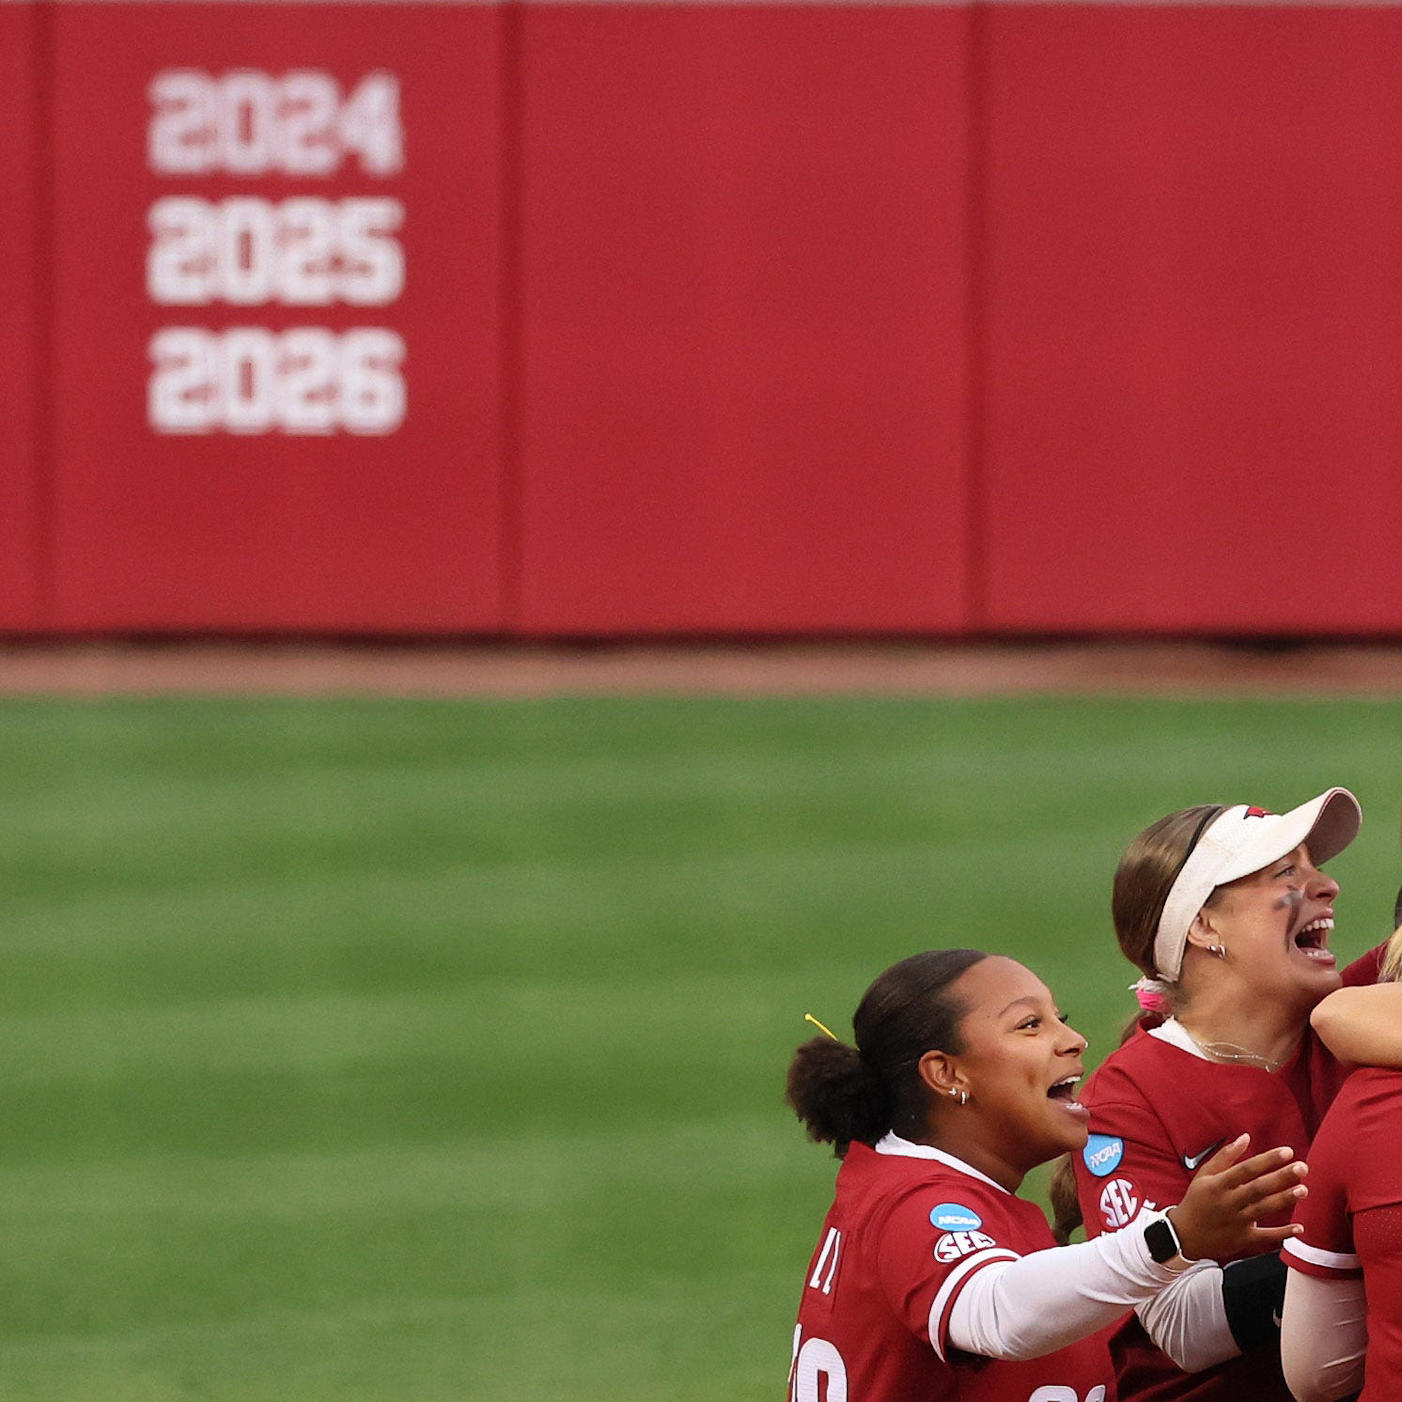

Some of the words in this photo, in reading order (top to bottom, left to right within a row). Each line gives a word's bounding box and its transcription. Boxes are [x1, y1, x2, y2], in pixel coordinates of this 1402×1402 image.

[147, 69, 404, 177] 2024
[147, 195, 406, 306] 2025
[147, 326, 407, 435] 2026
[1090, 1142, 1121, 1169] NCAA
[1100, 1179, 1138, 1228] SEC
